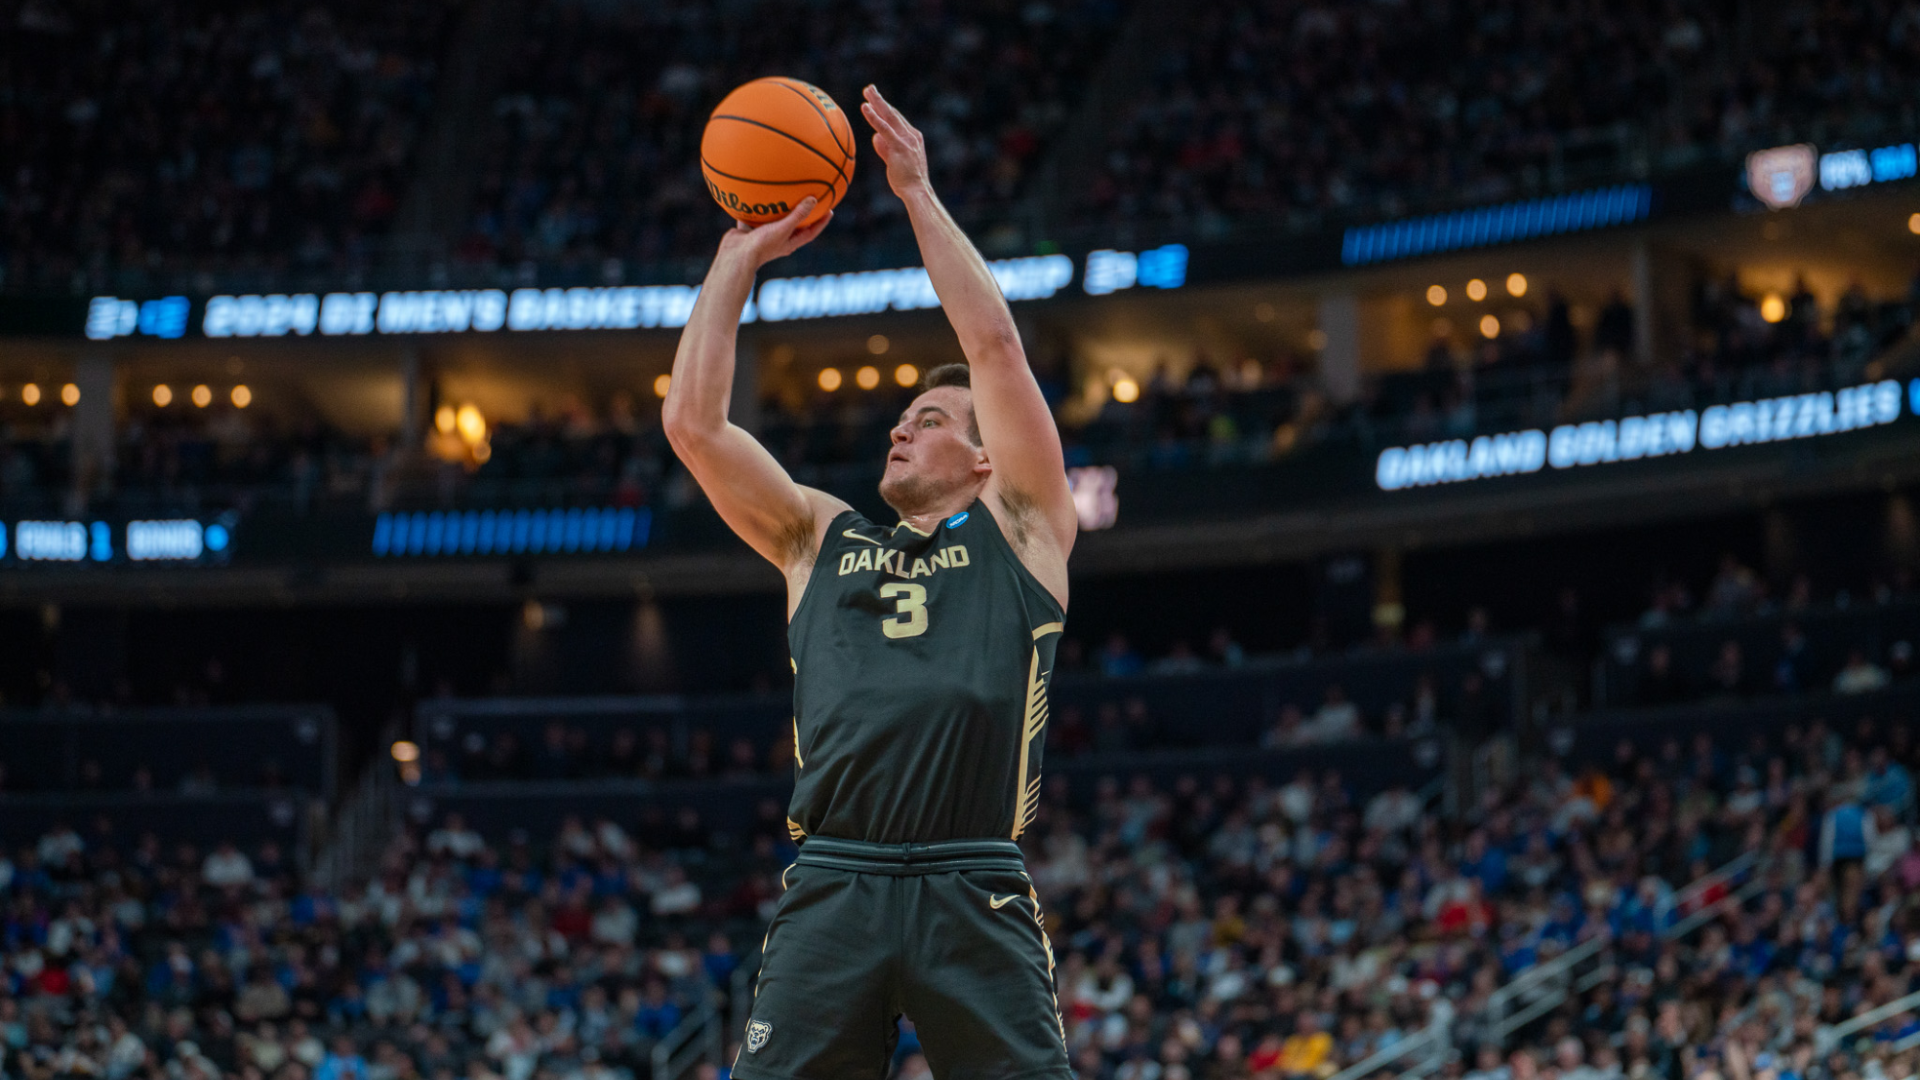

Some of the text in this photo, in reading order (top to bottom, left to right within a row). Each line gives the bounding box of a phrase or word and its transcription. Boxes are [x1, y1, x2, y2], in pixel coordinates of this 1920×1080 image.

[204, 294, 319, 337] 2024
[377, 290, 507, 333] MEN'S
[1376, 379, 1901, 490] OAKLAND GOLDEN GRIZZLIES
[838, 545, 970, 579] OAKLAND
[879, 582, 929, 639] 3
